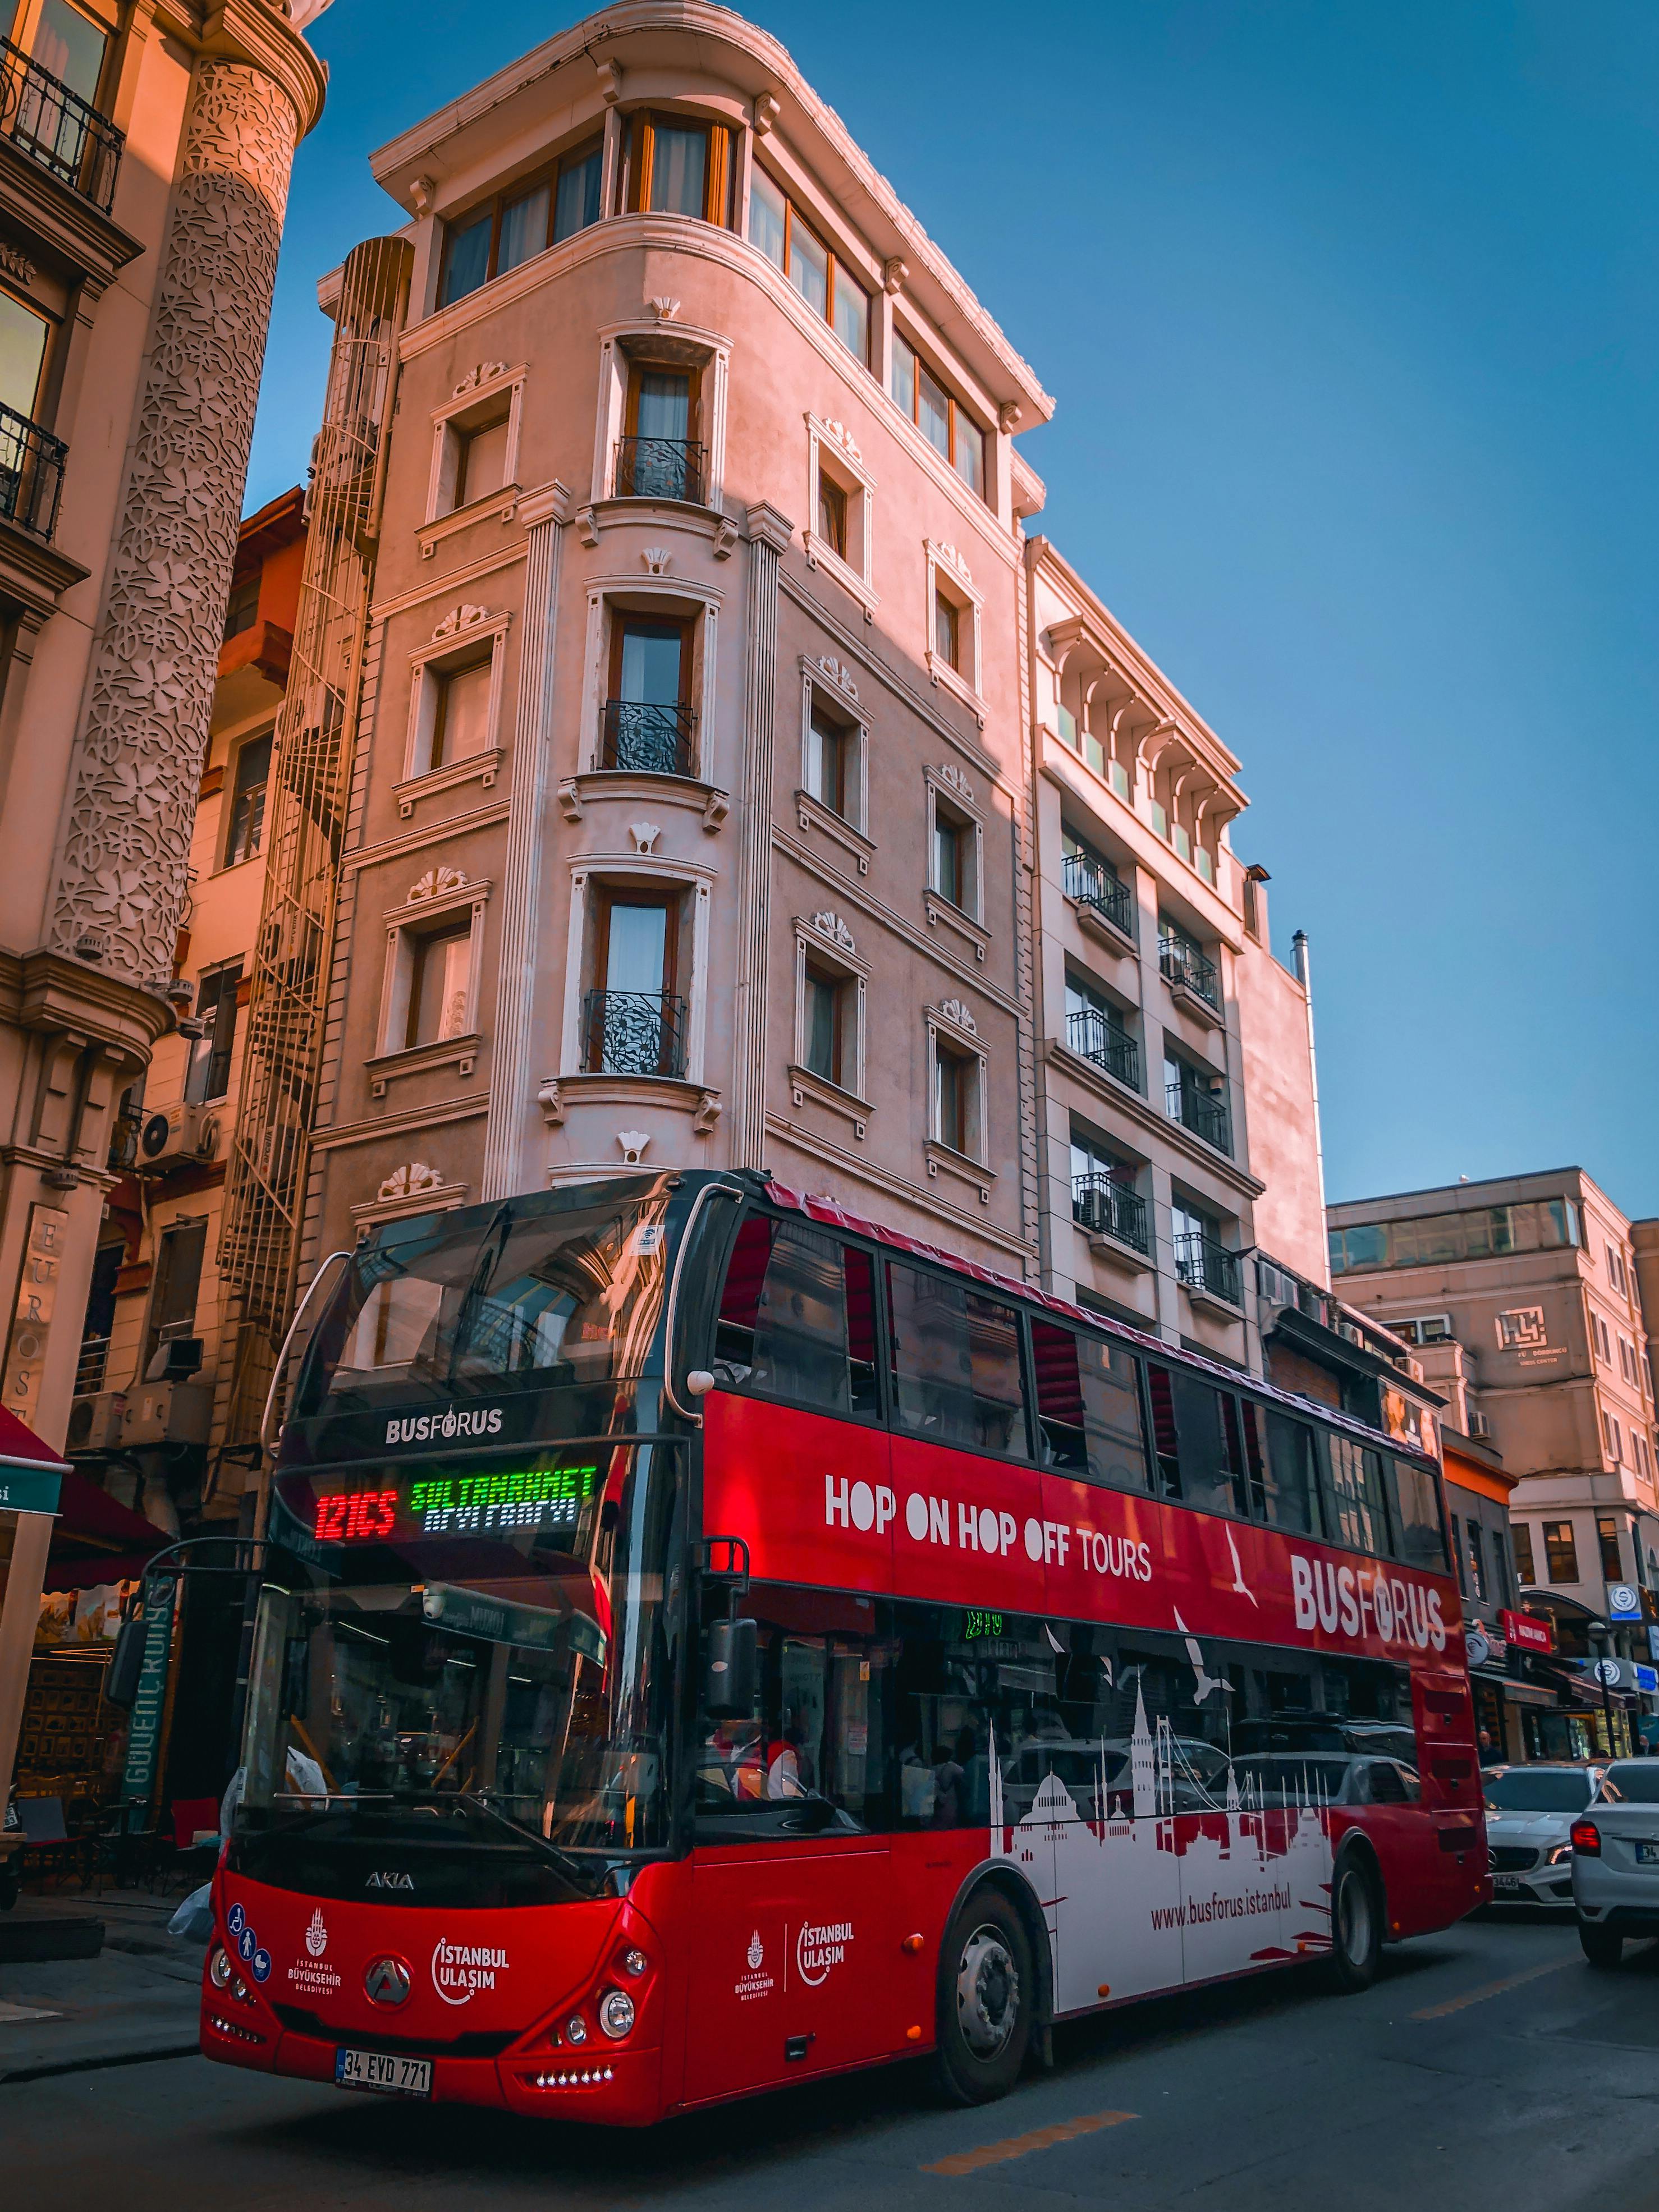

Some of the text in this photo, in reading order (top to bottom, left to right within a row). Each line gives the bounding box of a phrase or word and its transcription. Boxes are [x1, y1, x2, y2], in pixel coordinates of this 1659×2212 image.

[826, 1474, 1152, 1582] HOP ON HOP OFF TOURS
[365, 1871, 414, 1890] AKIA
[1151, 1881, 1291, 1931] www.busforus.istanbul
[288, 1967, 341, 1986] BÜYÜKŞEHİR
[344, 2052, 362, 2077] 34
[401, 2060, 427, 2088] 771
